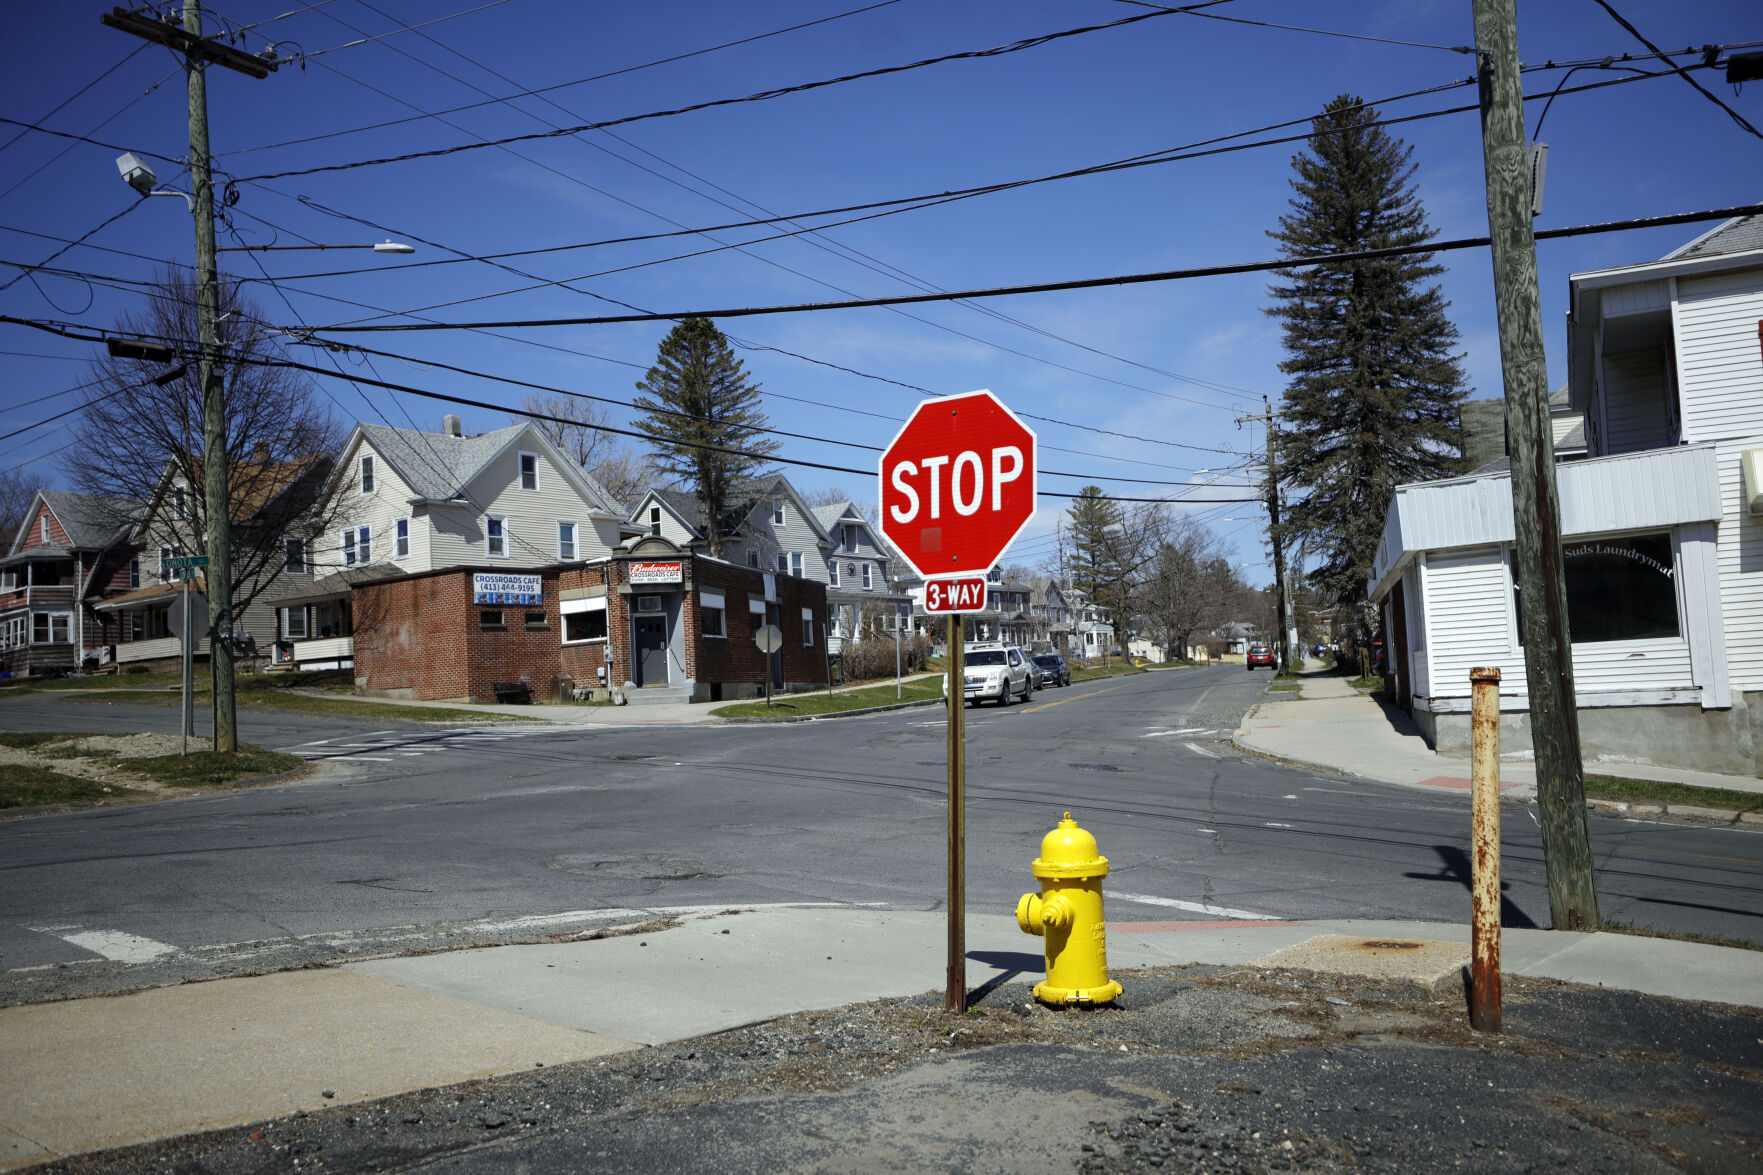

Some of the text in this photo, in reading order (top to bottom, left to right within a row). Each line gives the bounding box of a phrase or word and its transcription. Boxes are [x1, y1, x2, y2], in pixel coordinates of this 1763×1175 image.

[890, 445, 1024, 524] STOP
[631, 563, 680, 573] Budweiser
[1564, 544, 1674, 579] Suds Laundrymat
[475, 575, 522, 584] CROSSROADS
[480, 583, 500, 592] (413)
[928, 583, 981, 610] 3-WAY
